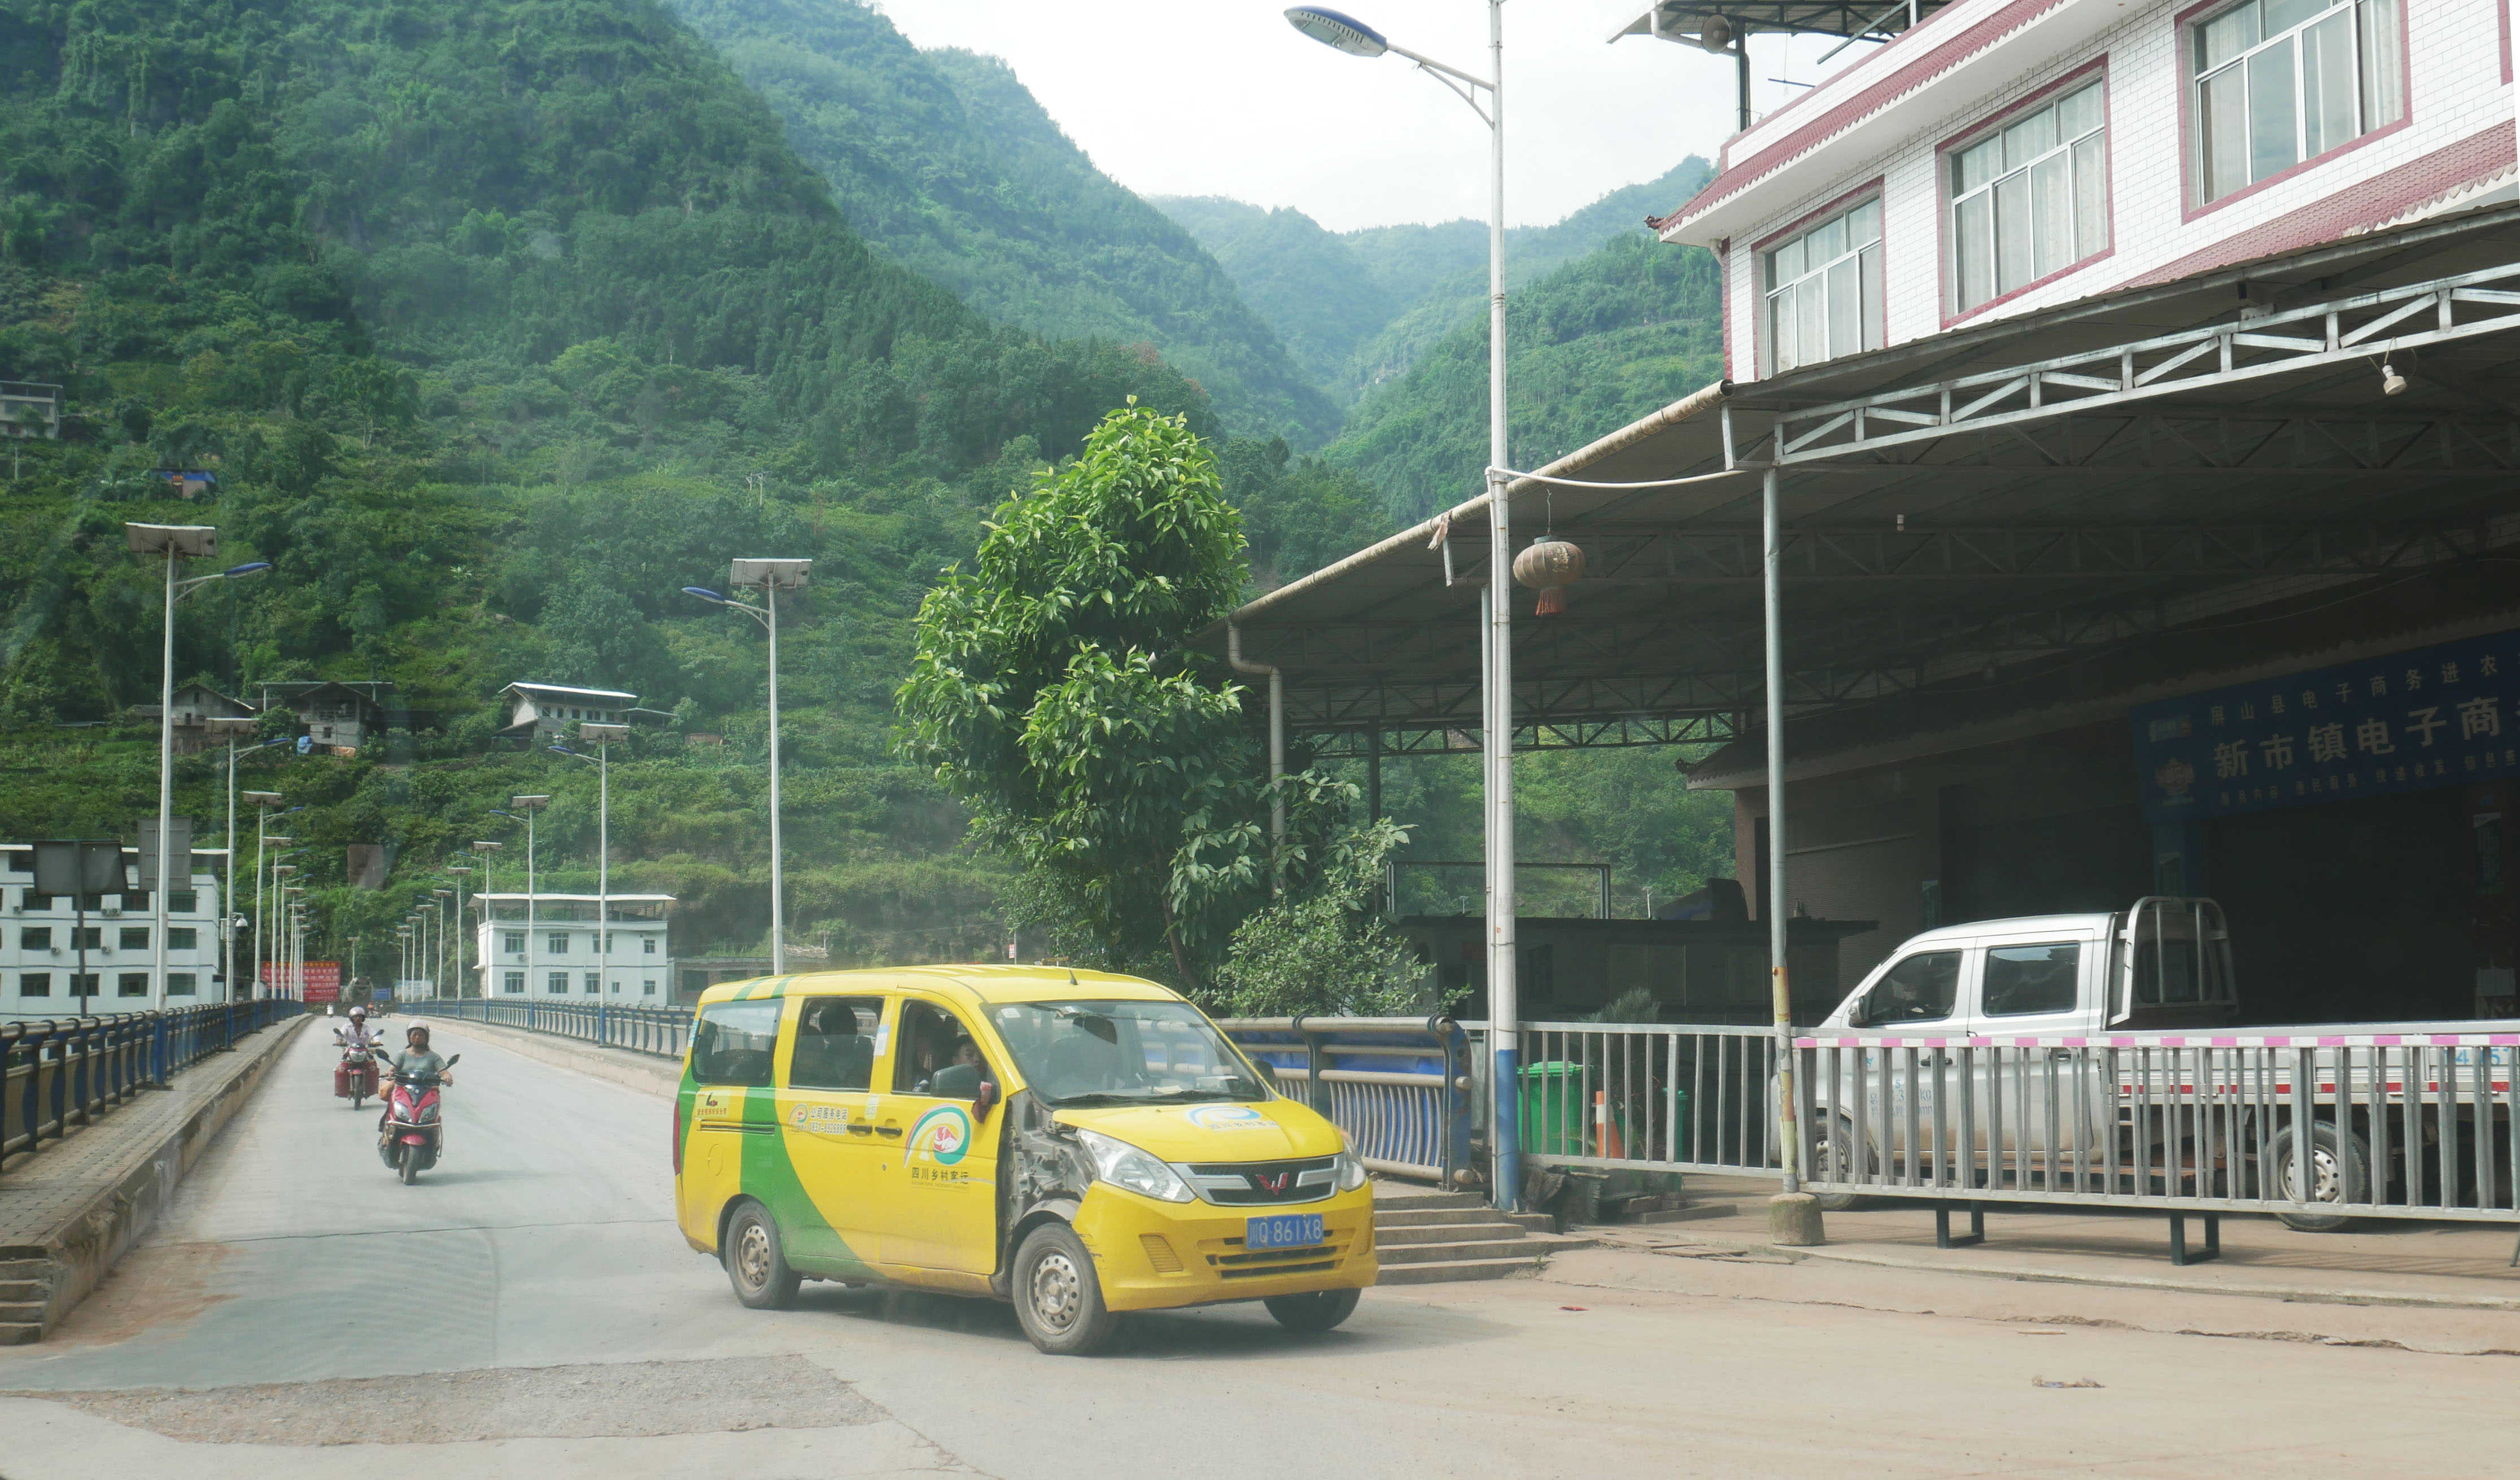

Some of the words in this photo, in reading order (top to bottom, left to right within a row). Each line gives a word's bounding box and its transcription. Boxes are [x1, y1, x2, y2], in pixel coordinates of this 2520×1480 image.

[2210, 652, 2520, 726] 屏山县电子商务进农
[2213, 696, 2520, 779] 新市镇电子商
[810, 1106, 848, 1120] 公司服务电话
[911, 1167, 969, 1185] 四川乡村客运
